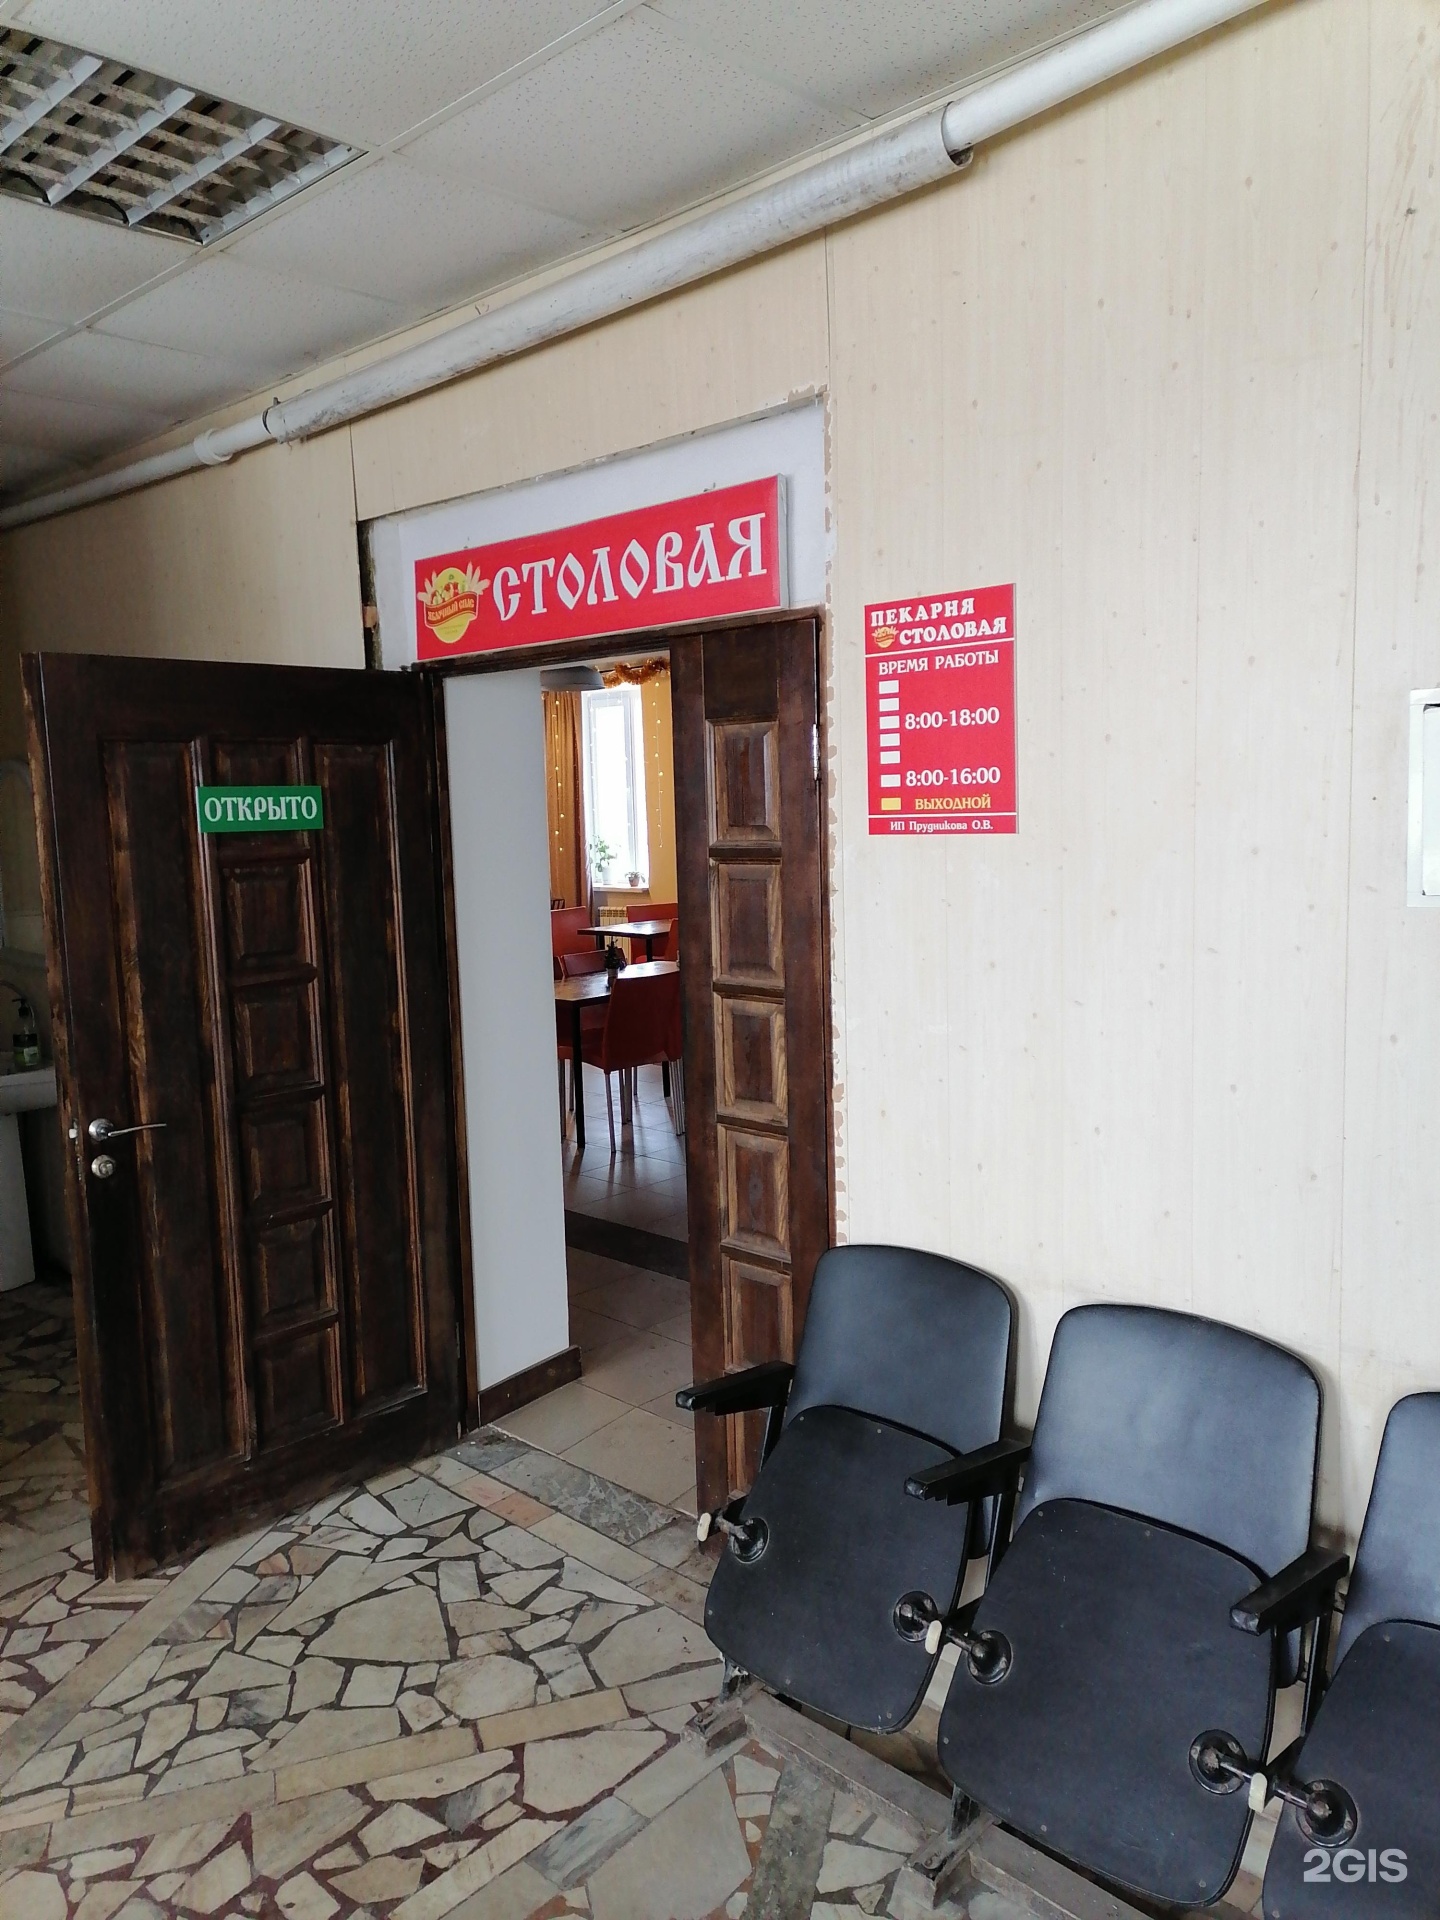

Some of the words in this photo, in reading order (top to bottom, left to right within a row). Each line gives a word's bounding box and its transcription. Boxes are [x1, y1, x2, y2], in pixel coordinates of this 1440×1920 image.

[492, 512, 768, 621] СТОЛОВАЯ
[870, 598, 975, 627] ПЕКАРНЯ
[899, 617, 1007, 645] СТОЛОВАЯ
[878, 658, 929, 675] ВРЕМЯ
[935, 649, 999, 670] РАБОТЫ
[904, 707, 1000, 730] 8:00-18:00
[905, 767, 1001, 787] 8:00-16:00
[204, 796, 318, 822] ОТКРЫТО
[914, 793, 991, 811] ВЫХОДНОЙ
[890, 821, 905, 831] ИП
[909, 820, 968, 833] Прудникова
[971, 820, 994, 830] О.В.
